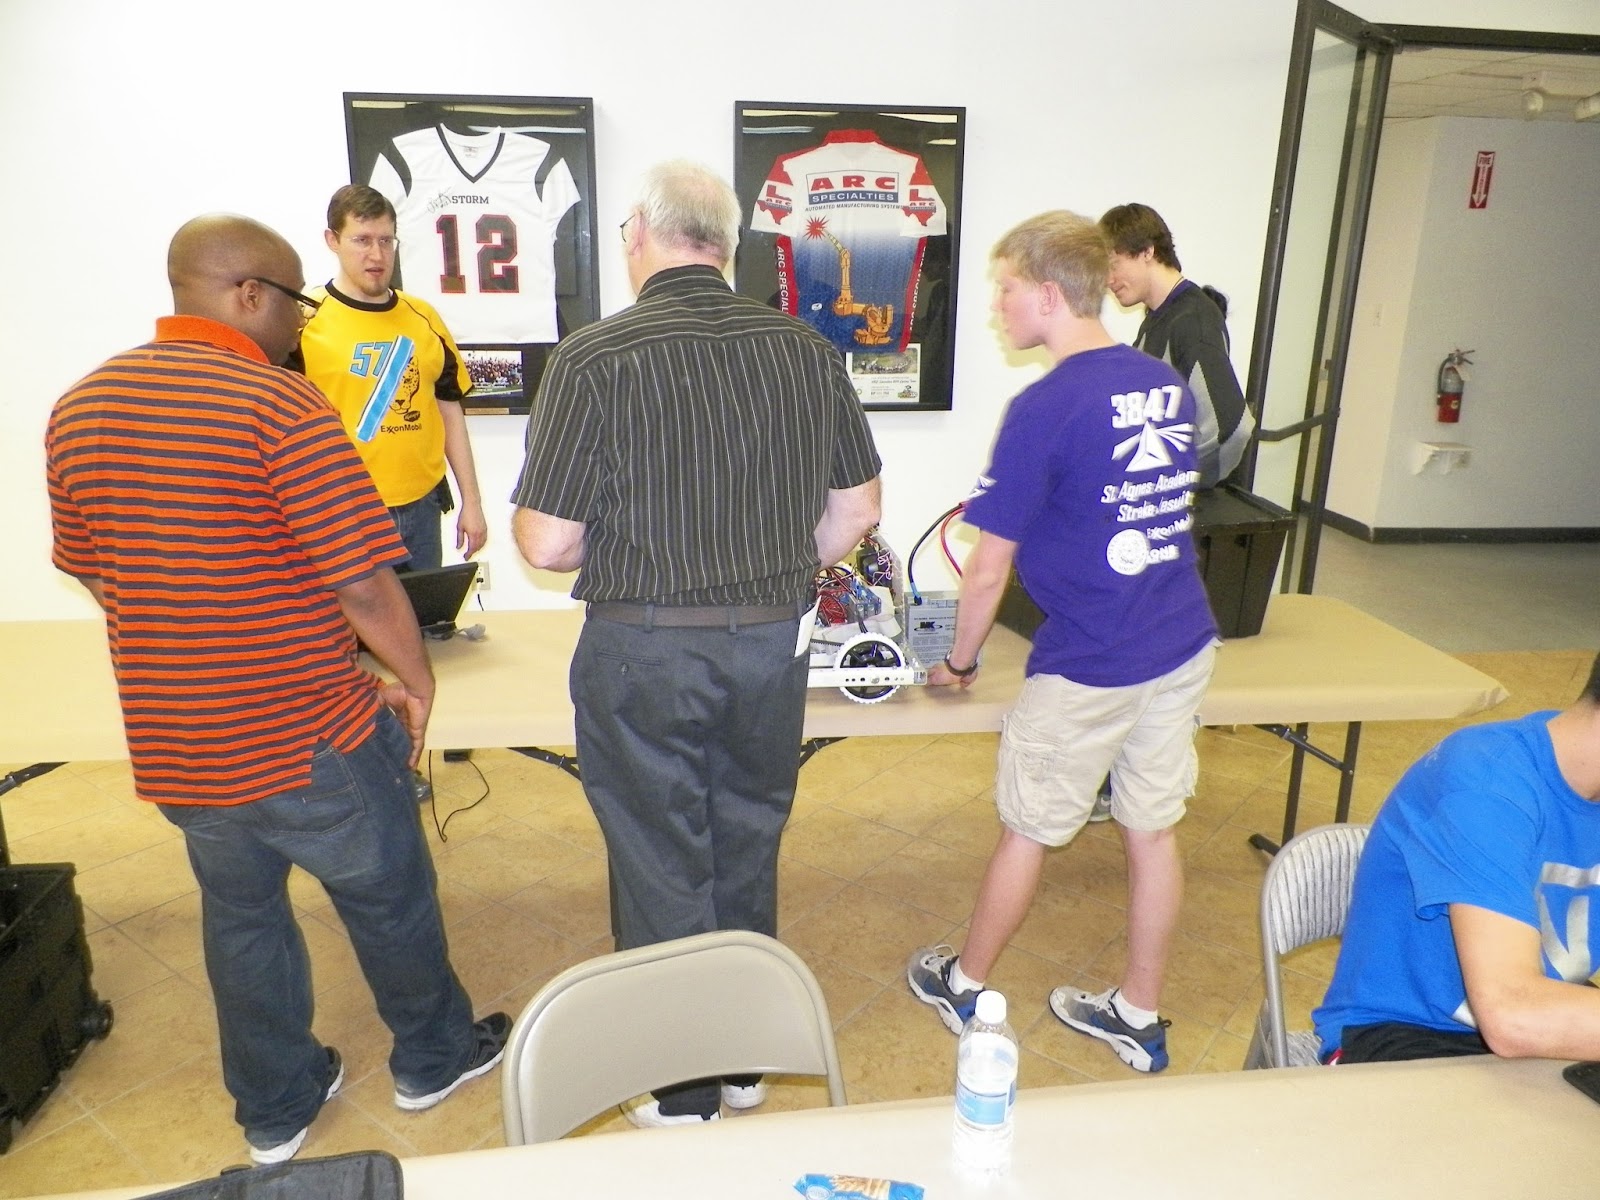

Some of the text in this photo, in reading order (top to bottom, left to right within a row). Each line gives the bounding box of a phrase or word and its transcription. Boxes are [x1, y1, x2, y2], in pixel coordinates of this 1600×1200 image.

[810, 175, 896, 192] ARC
[451, 195, 489, 204] STORM
[812, 192, 894, 202] SPECIALTIES
[436, 214, 519, 293] 12
[777, 246, 789, 314] ARC SPECIAL
[350, 342, 393, 377] 57
[1111, 385, 1182, 429] 3847
[380, 423, 422, 434] ExxonMobil
